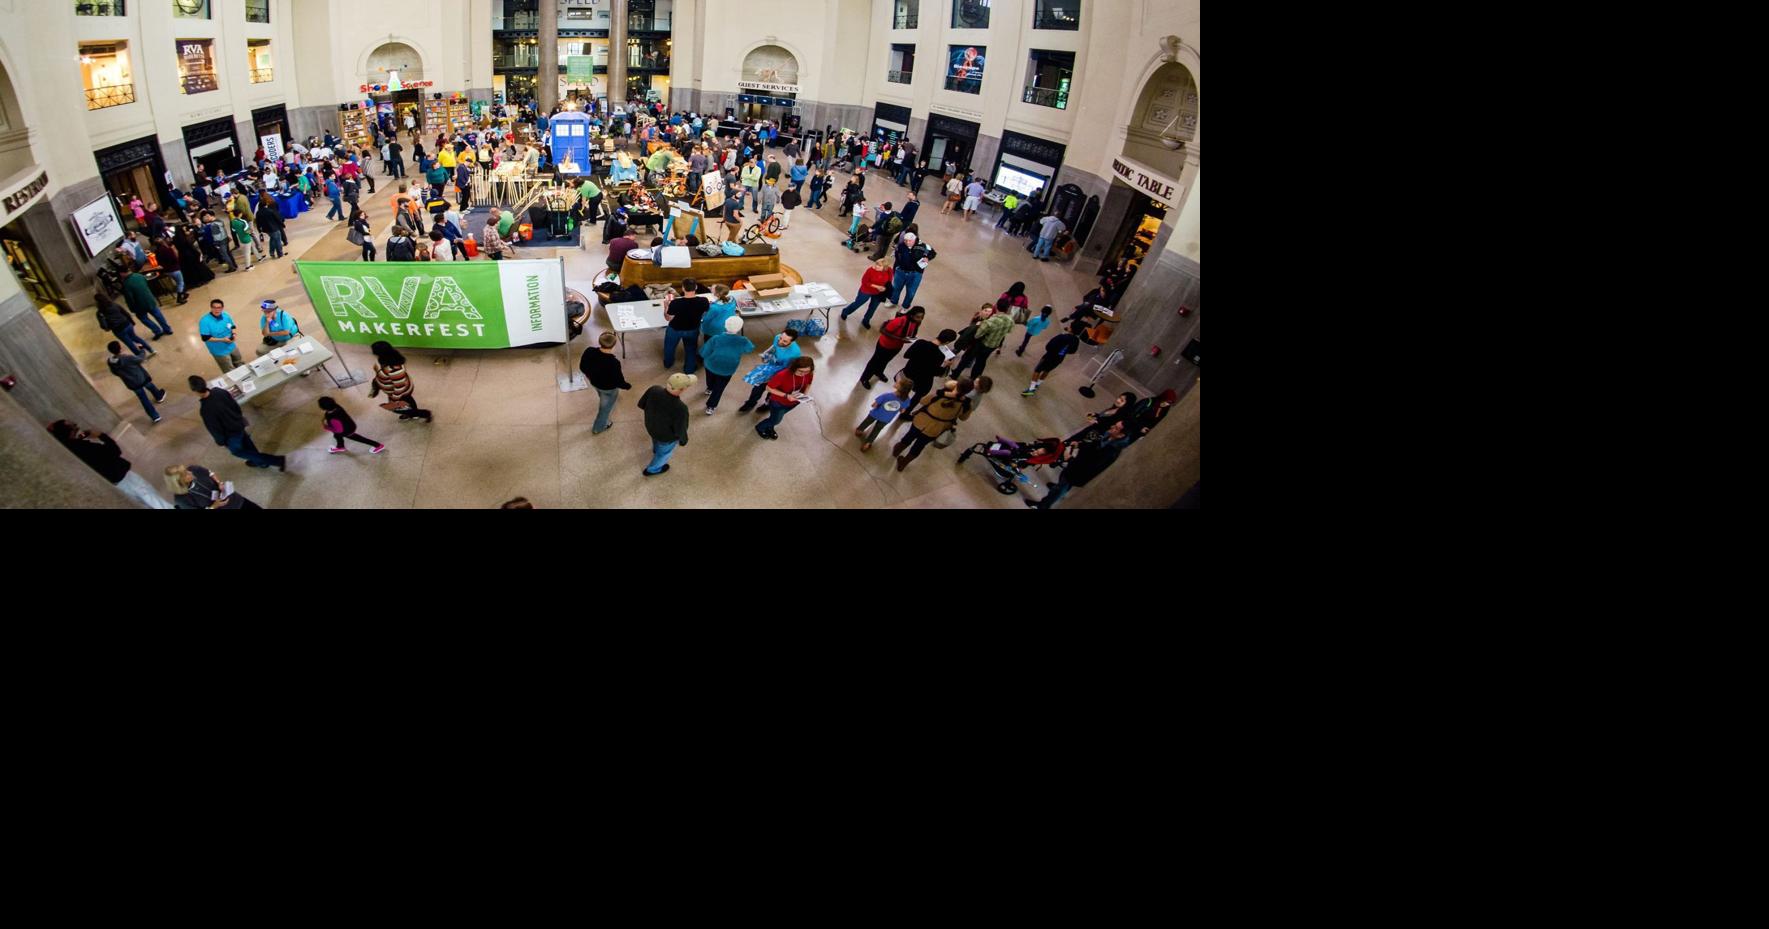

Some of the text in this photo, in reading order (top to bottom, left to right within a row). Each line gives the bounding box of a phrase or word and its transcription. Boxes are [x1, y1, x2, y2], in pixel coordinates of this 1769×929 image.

[183, 44, 204, 55] RVA
[360, 83, 388, 93] Shop
[266, 137, 279, 161] CODERS
[1137, 172, 1175, 201] TABLE
[320, 275, 483, 319] RVA
[526, 274, 543, 332] INFORMATION
[337, 319, 486, 337] MAKERFEST
